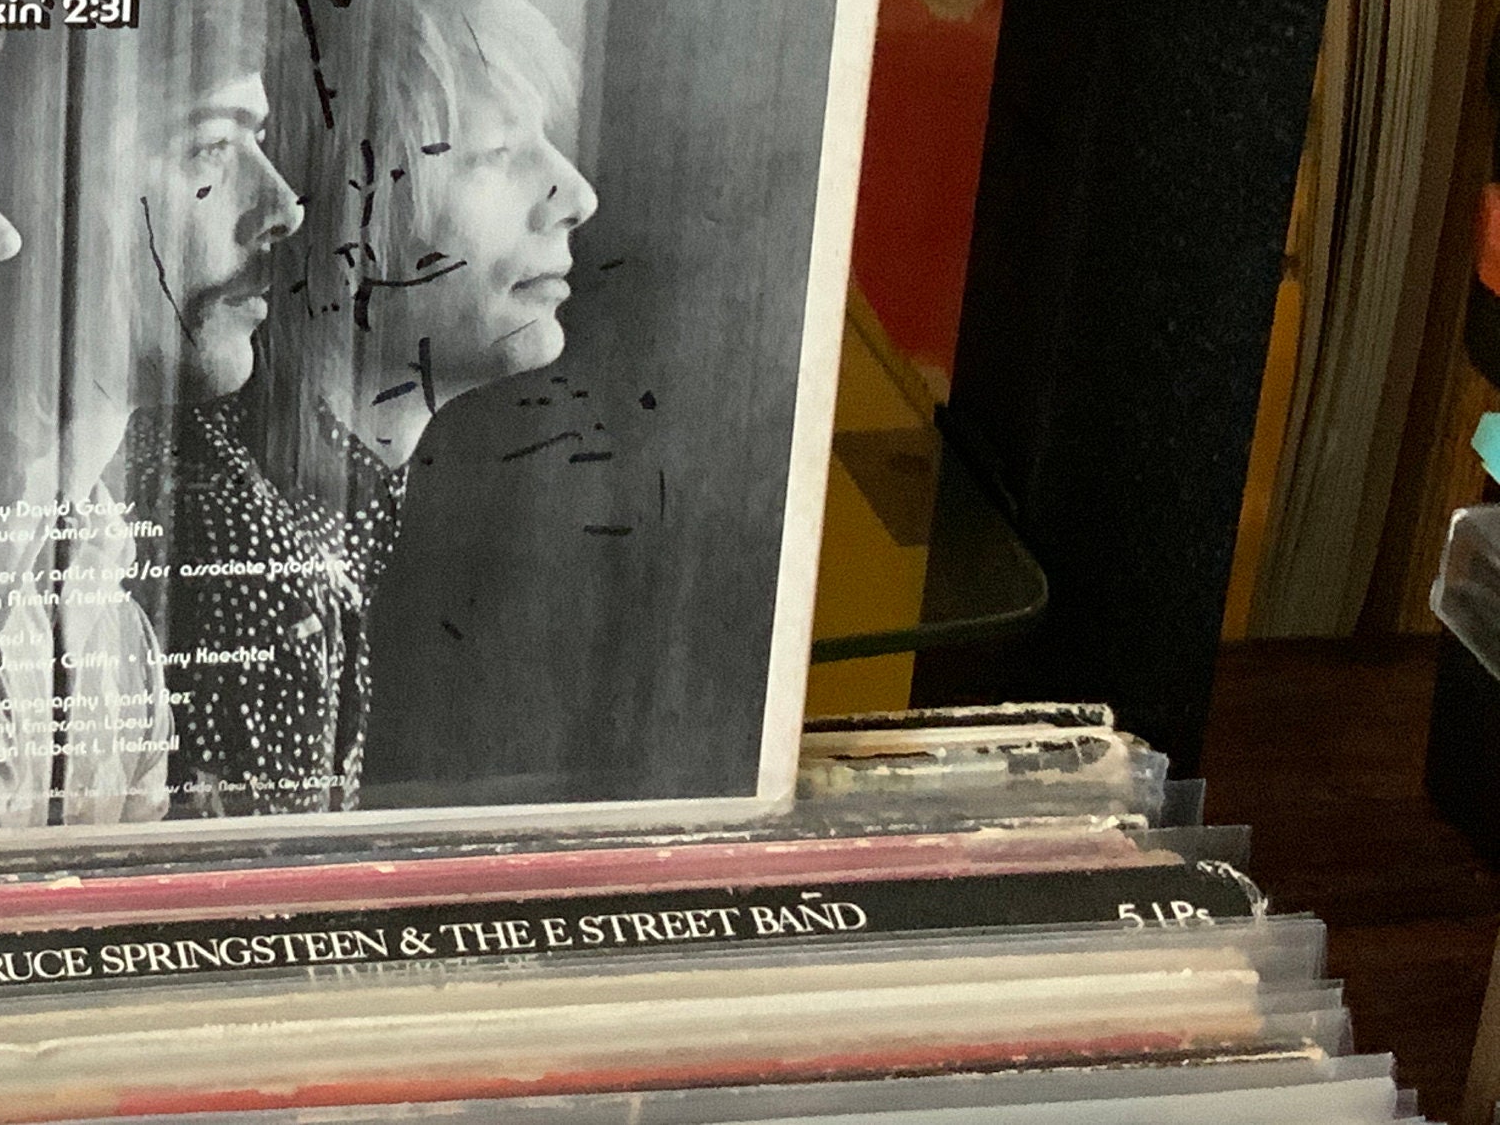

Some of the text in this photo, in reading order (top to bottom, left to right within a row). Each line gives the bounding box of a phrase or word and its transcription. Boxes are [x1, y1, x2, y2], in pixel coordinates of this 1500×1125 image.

[16, 499, 70, 518] David
[75, 499, 135, 516] Gates
[41, 522, 98, 542] James
[49, 563, 96, 581] artist
[179, 558, 266, 577] associate
[146, 648, 191, 669] Larry
[195, 646, 275, 666] Knechtel
[100, 928, 390, 976] SPRINGSTEEN
[400, 926, 434, 956] &
[439, 919, 537, 953] THE
[541, 917, 574, 947] E
[577, 906, 741, 945] STREET
[748, 901, 868, 937] BAND
